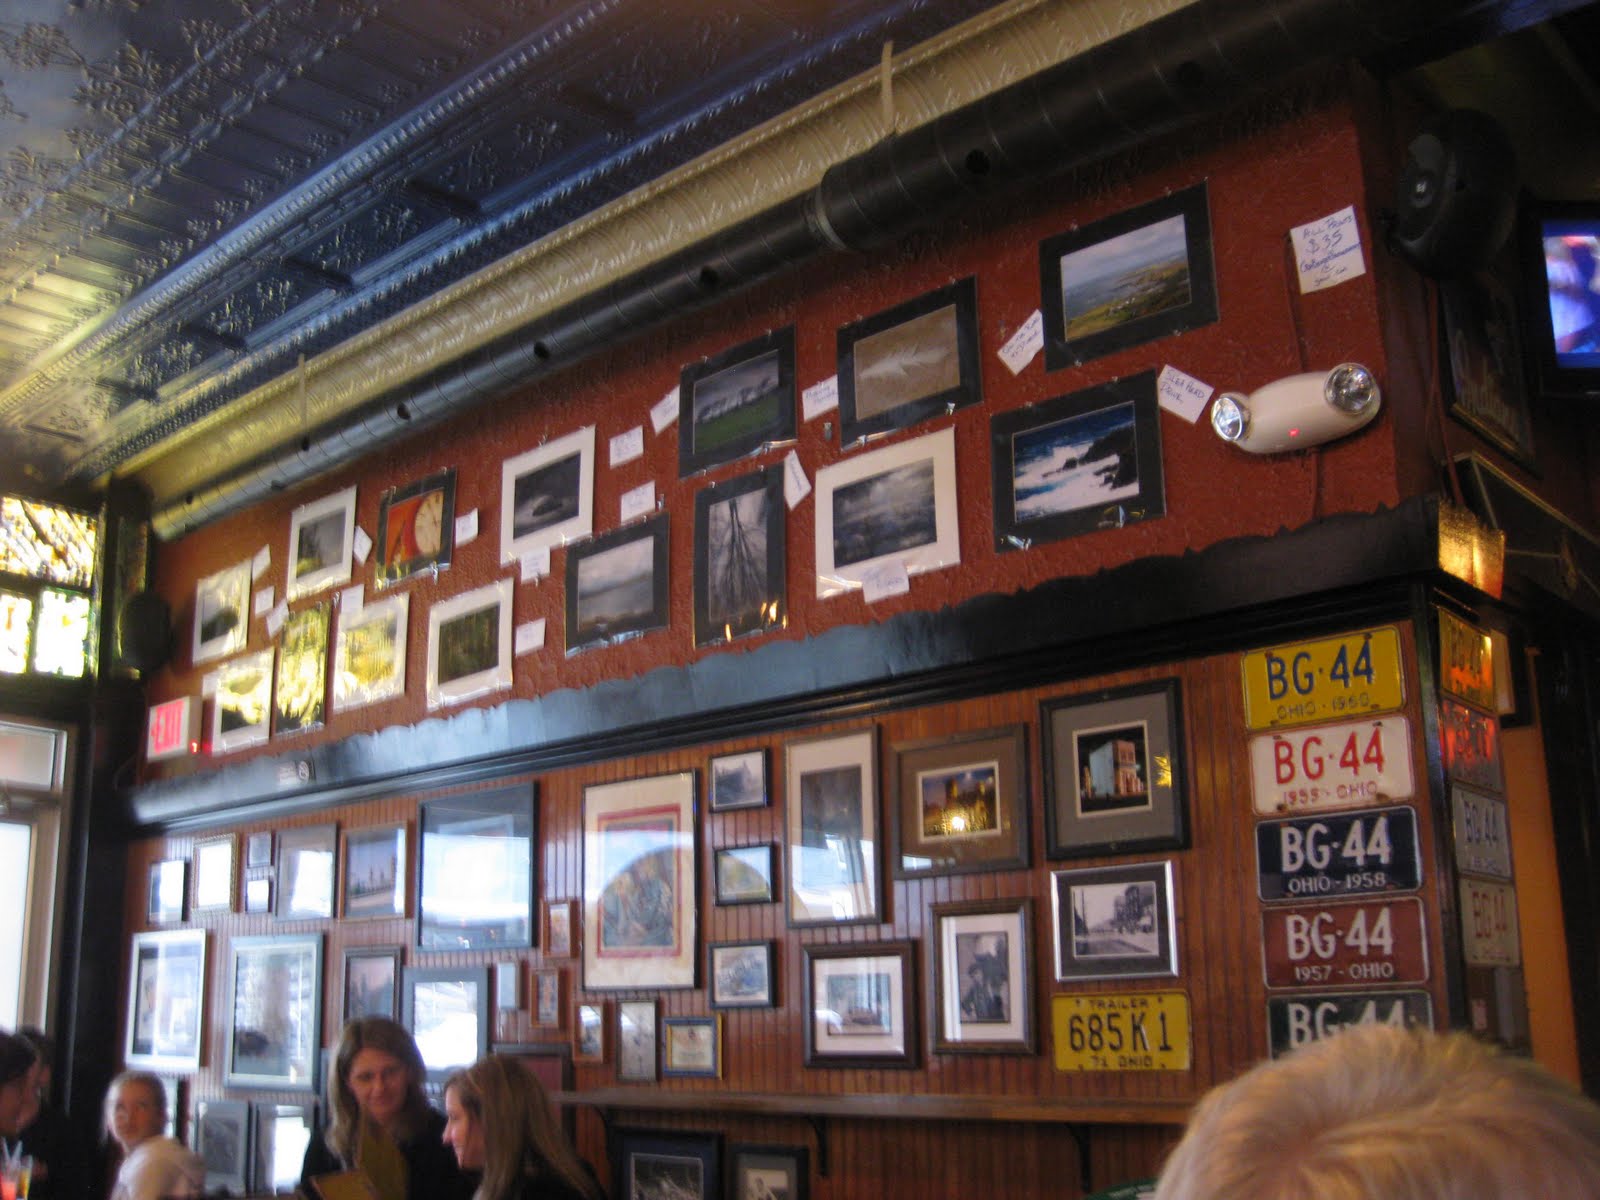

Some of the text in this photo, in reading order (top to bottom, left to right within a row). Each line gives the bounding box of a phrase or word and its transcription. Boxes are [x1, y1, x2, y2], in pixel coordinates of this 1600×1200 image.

[1277, 701, 1316, 719] OHIO
[1336, 781, 1378, 799] OHIO
[1288, 872, 1387, 893] OHIO 1958
[1295, 962, 1394, 982] 1957 OHIO
[1089, 998, 1149, 1009] TRAILER
[1119, 1055, 1153, 1068] OHIO
